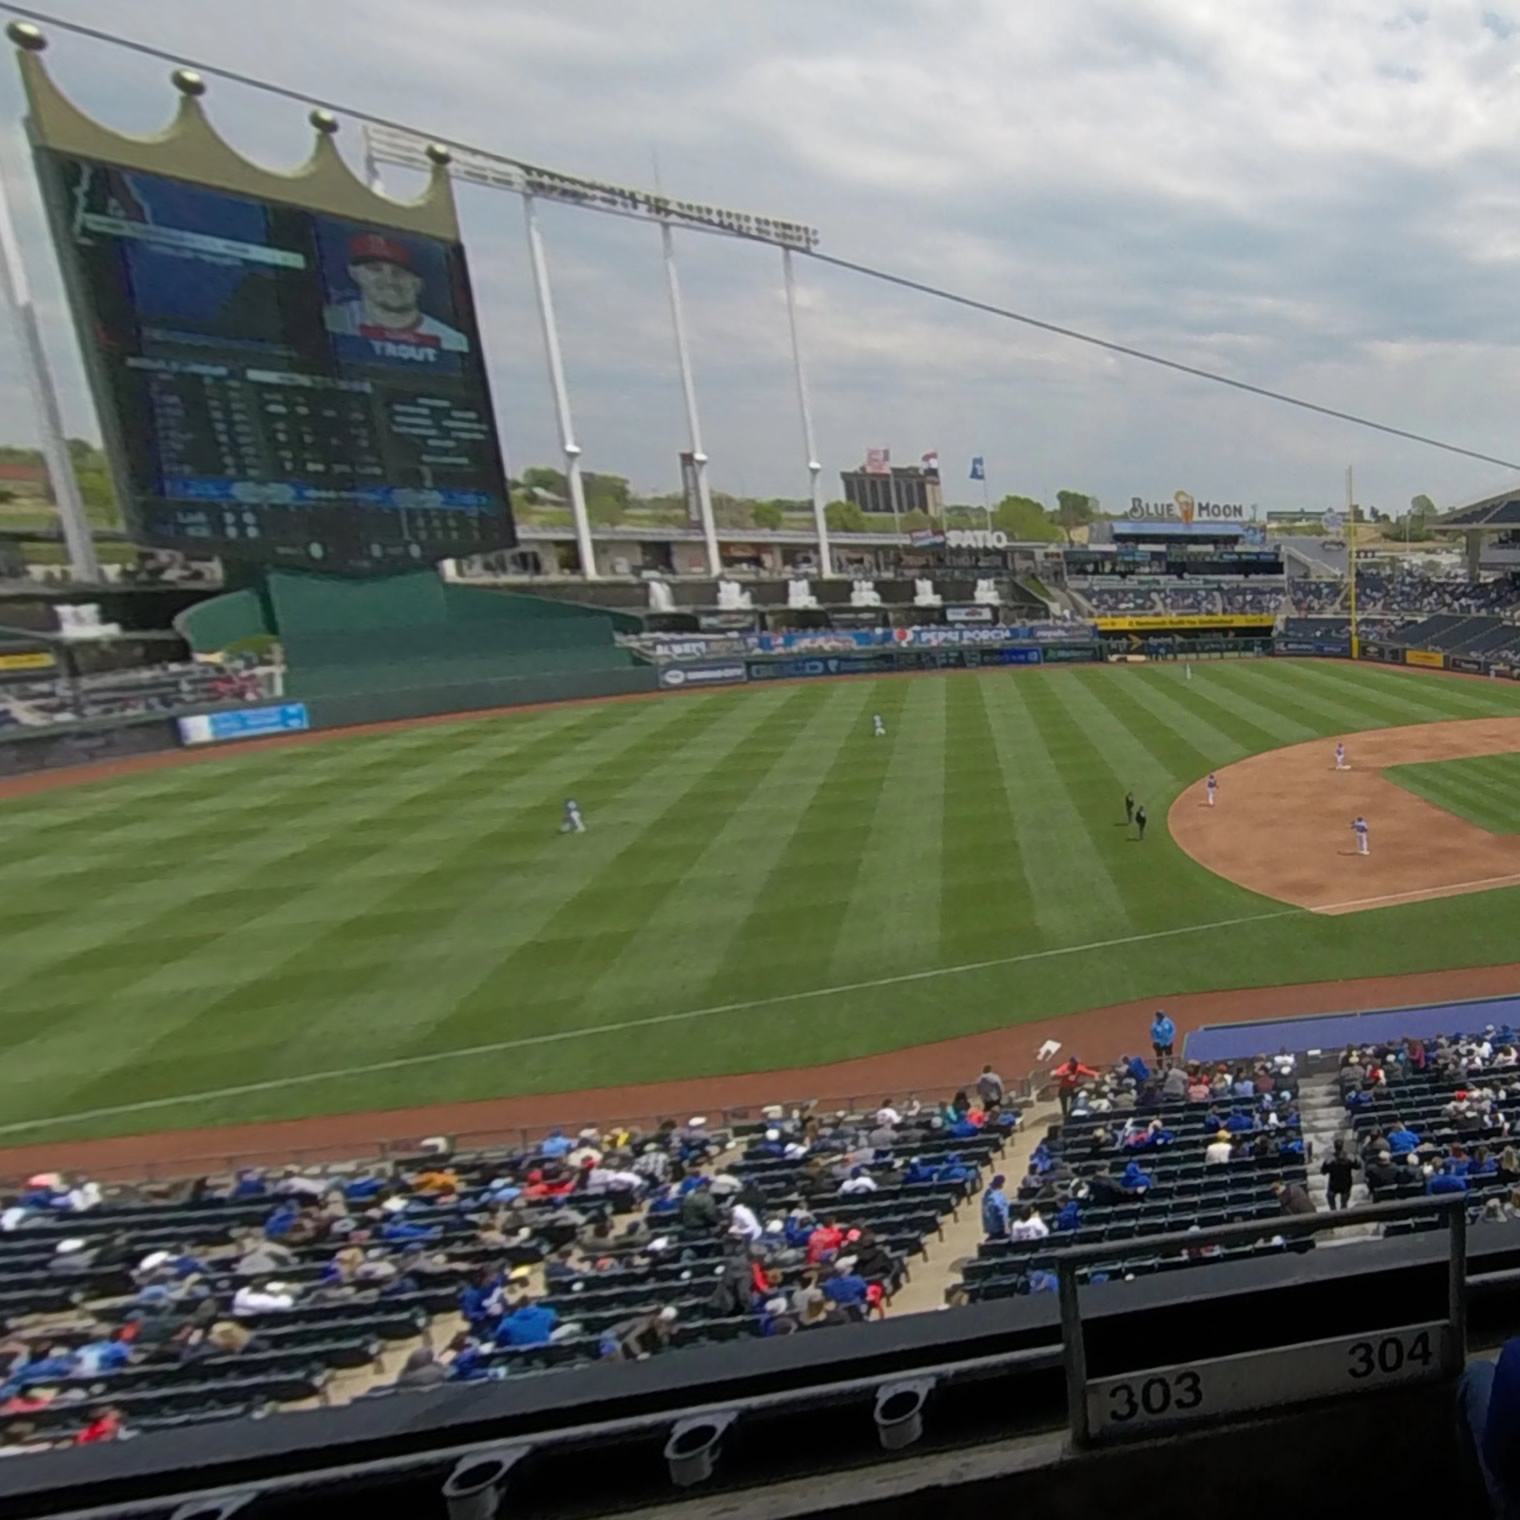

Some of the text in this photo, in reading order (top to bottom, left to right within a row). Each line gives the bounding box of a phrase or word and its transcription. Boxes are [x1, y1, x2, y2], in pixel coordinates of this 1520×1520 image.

[367, 339, 438, 363] TROUT
[1128, 497, 1243, 520] BLUE MOON
[945, 530, 1008, 549] PATIO
[920, 629, 1011, 642] PEPSI PORCH
[1347, 1330, 1433, 1380] 304
[1108, 1370, 1204, 1423] 303
